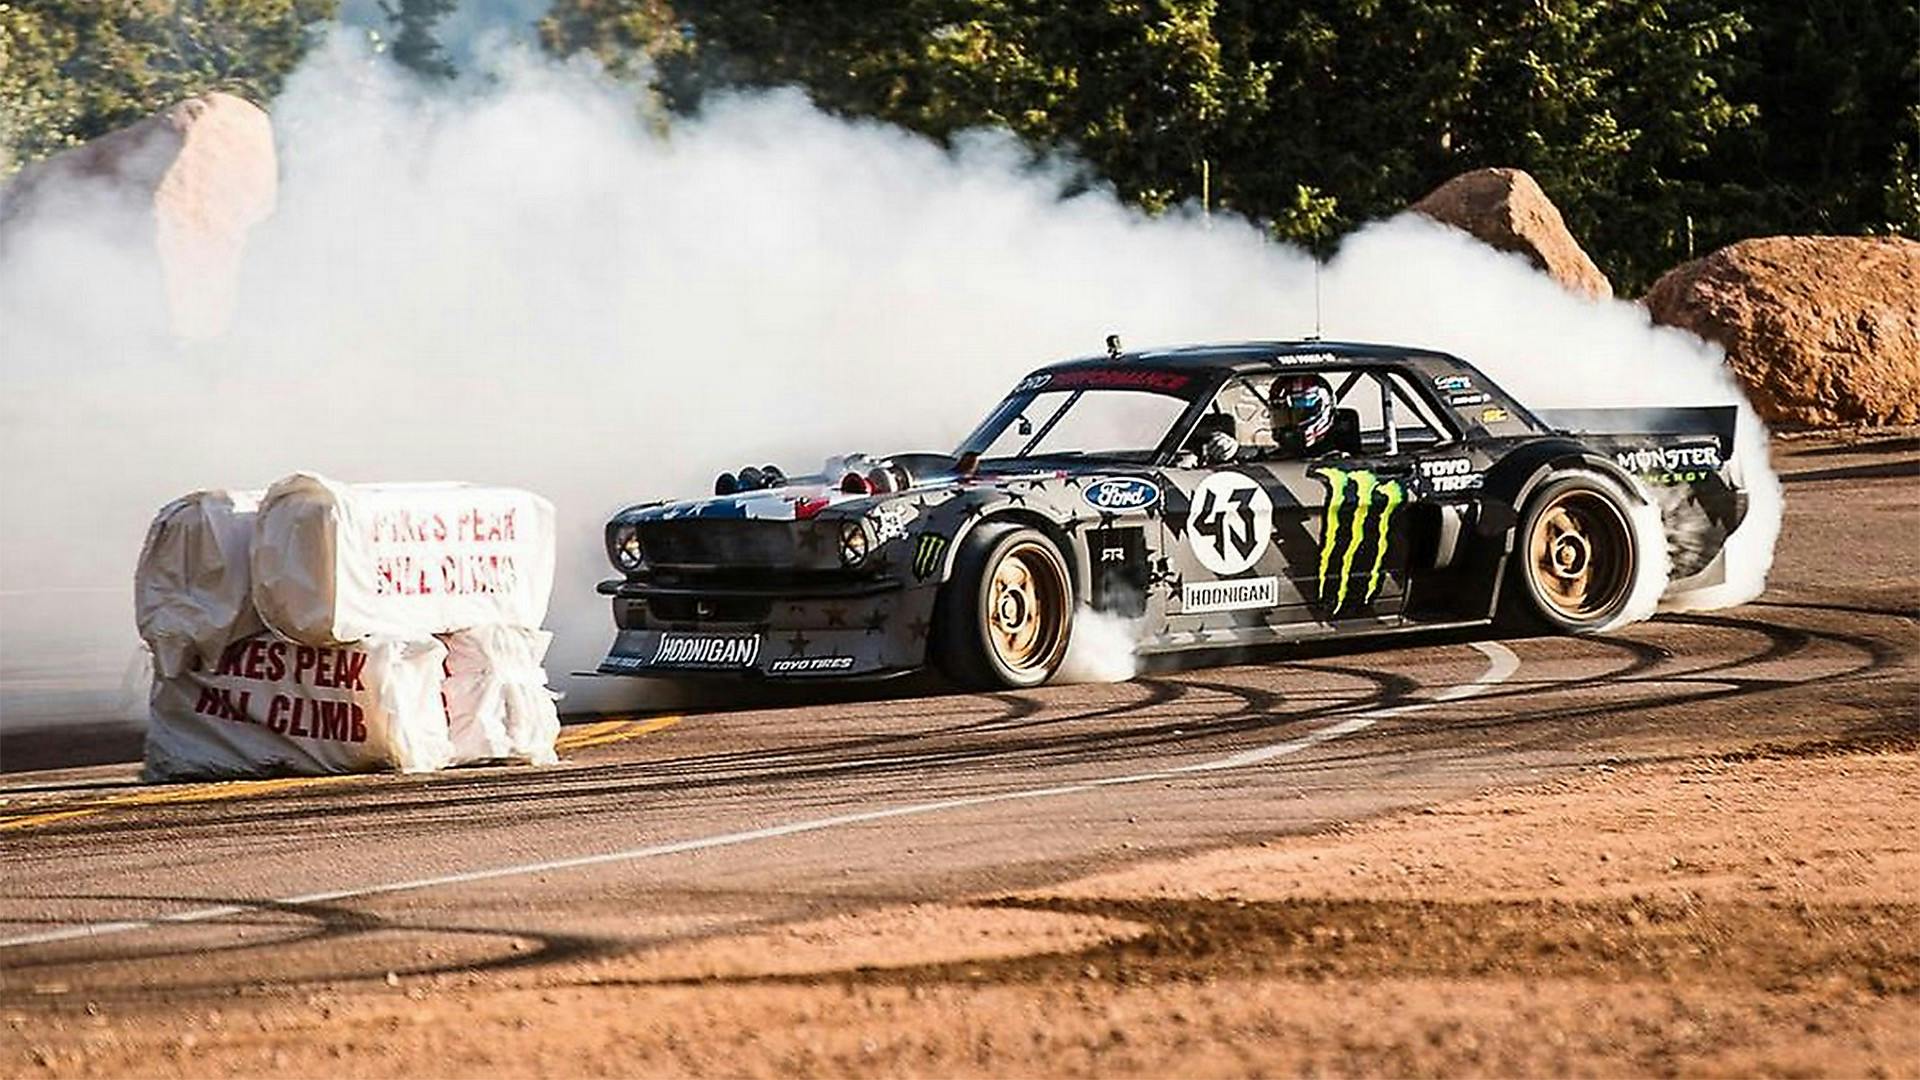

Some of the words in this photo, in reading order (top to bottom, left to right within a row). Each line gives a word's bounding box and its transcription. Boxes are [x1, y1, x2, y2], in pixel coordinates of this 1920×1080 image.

[1420, 459, 1471, 477] TOYO
[1617, 447, 1721, 472] MONSTER
[1096, 482, 1147, 508] Ford
[1431, 474, 1484, 492] TIRES
[1193, 488, 1260, 561] 43
[295, 645, 367, 691] PEAK
[772, 659, 810, 670] TOYO
[810, 657, 853, 669] TIRES
[267, 694, 367, 742] CLIMB
